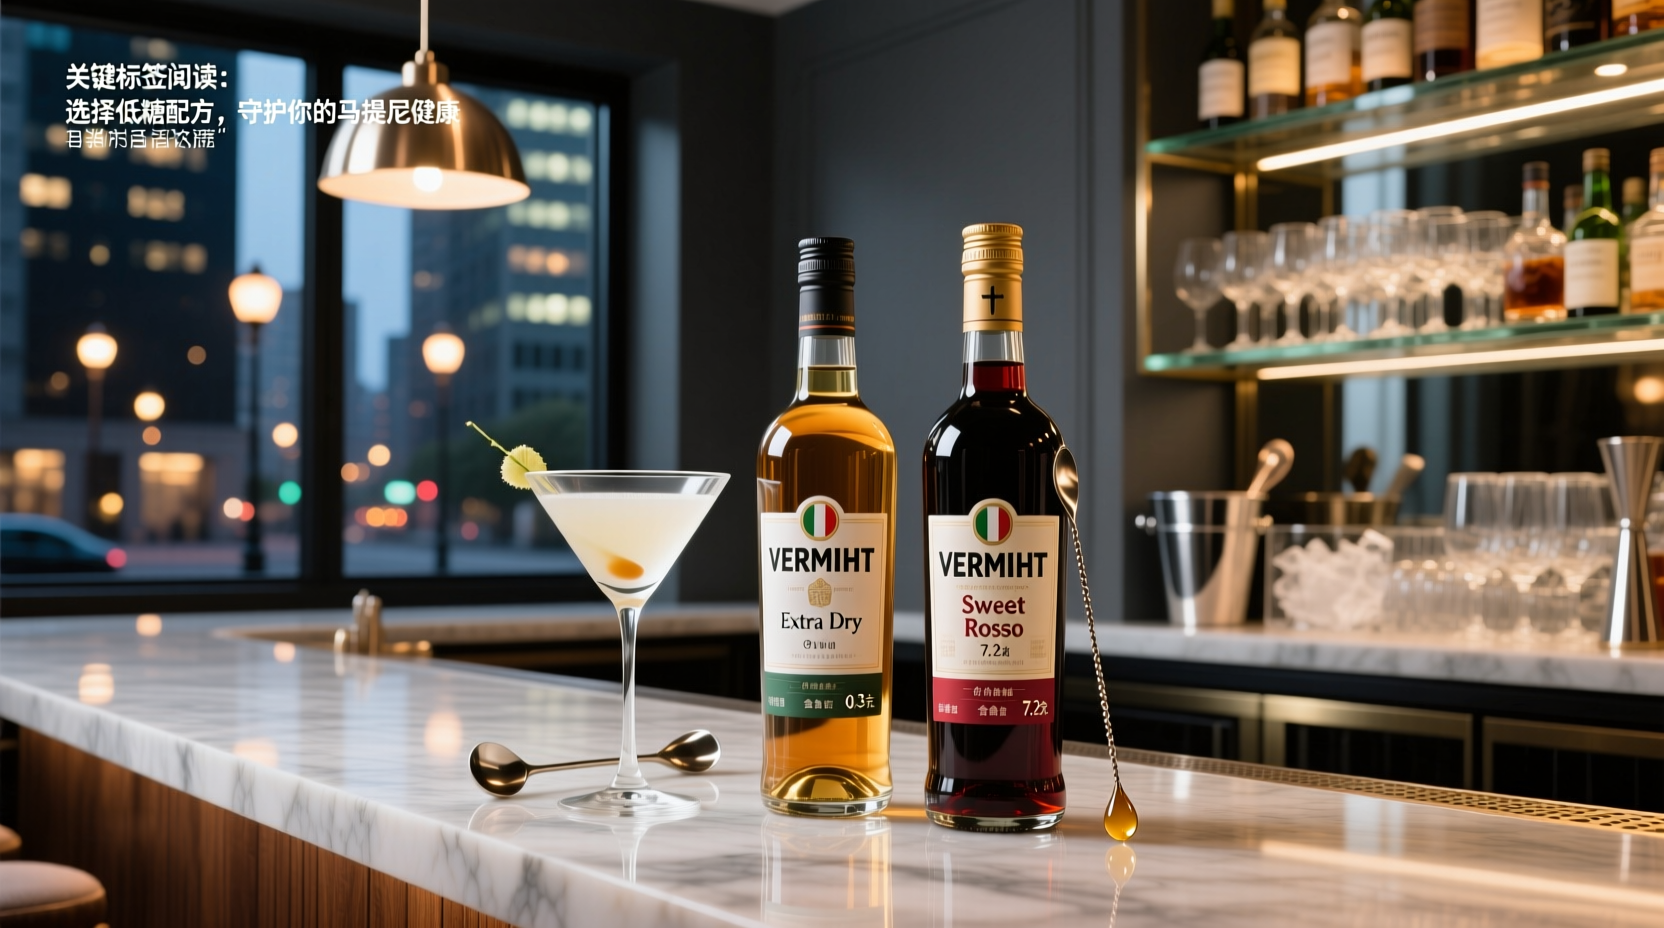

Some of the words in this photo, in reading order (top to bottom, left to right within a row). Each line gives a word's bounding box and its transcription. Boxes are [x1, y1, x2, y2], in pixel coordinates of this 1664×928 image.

[769, 547, 875, 573] VERMIHT
[938, 551, 1048, 578] VERMIHT
[961, 594, 1026, 615] Sweet
[781, 612, 823, 630] Extra
[829, 612, 863, 635] Dry
[964, 618, 1024, 638] Rosso
